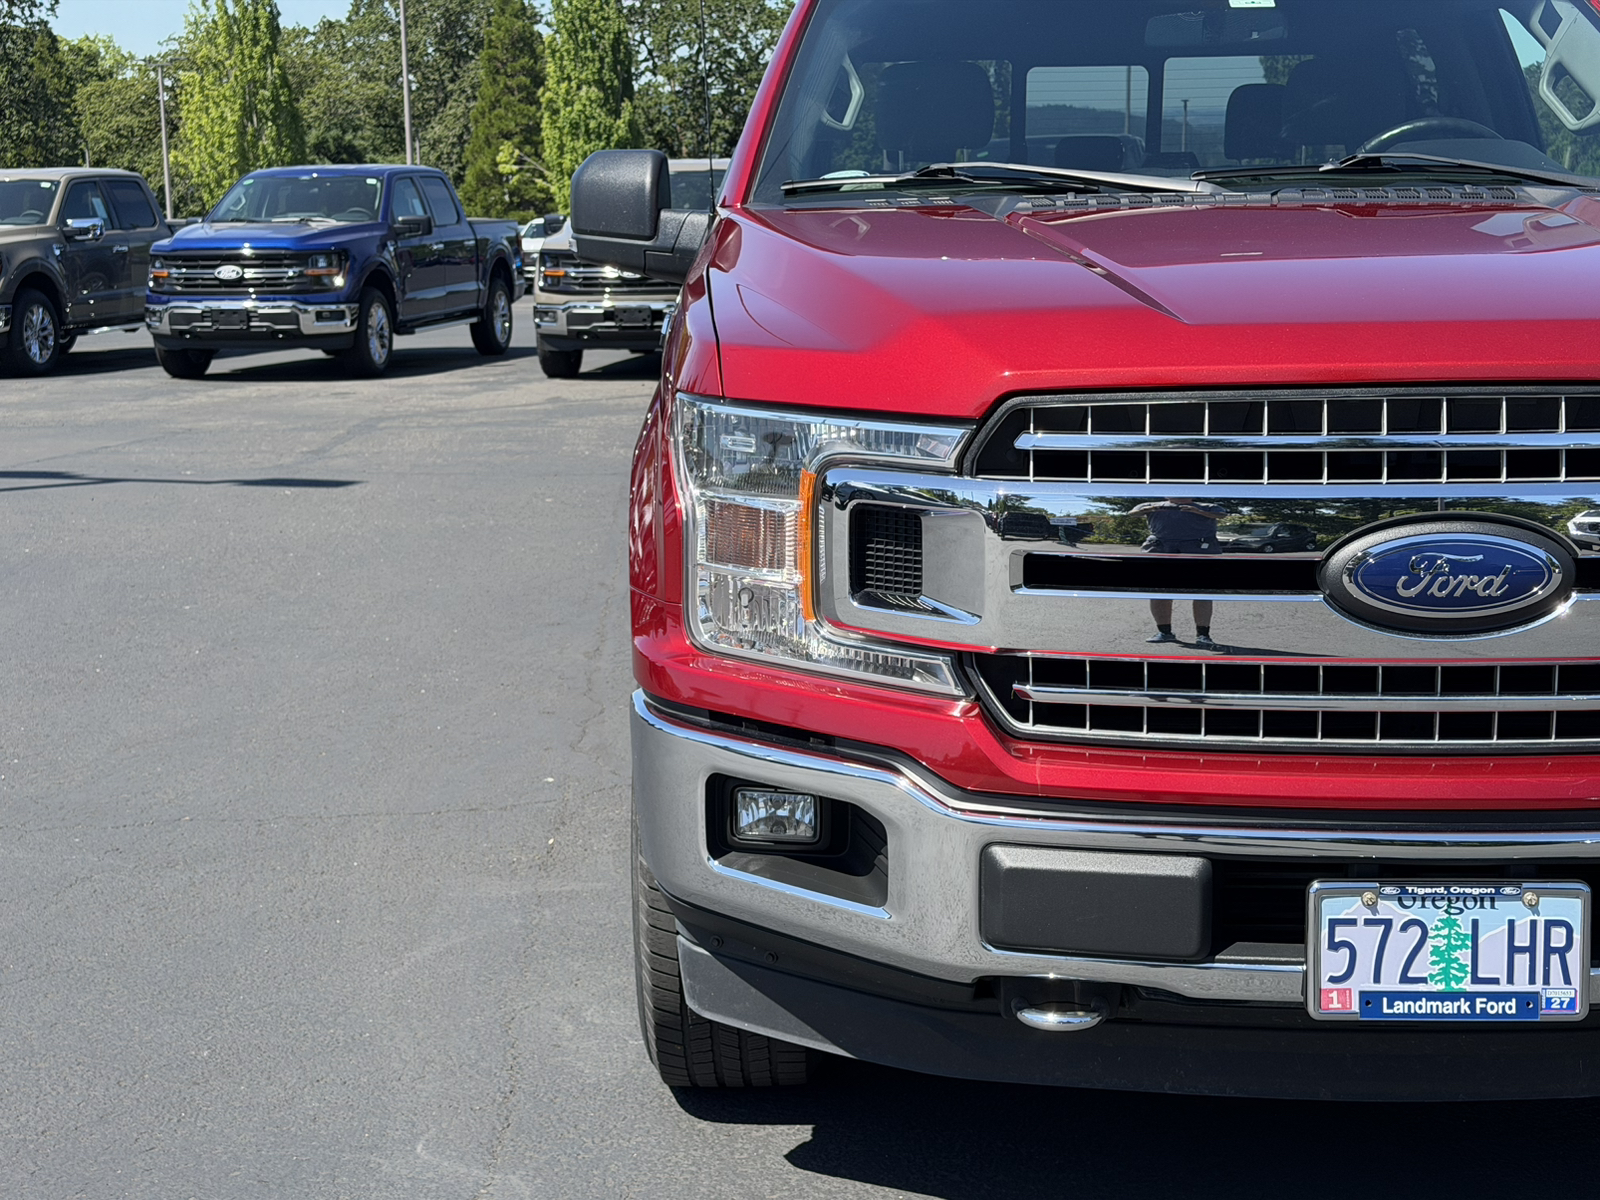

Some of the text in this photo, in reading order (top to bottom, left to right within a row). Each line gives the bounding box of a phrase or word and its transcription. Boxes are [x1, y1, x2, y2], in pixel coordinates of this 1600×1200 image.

[1396, 552, 1510, 598] Ford
[1405, 886, 1495, 895] Tigard, Oregon
[1326, 918, 1574, 986] 572 LHR
[1328, 990, 1342, 1009] 1
[1382, 997, 1517, 1015] Landmark Ford
[1550, 997, 1570, 1009] 27
